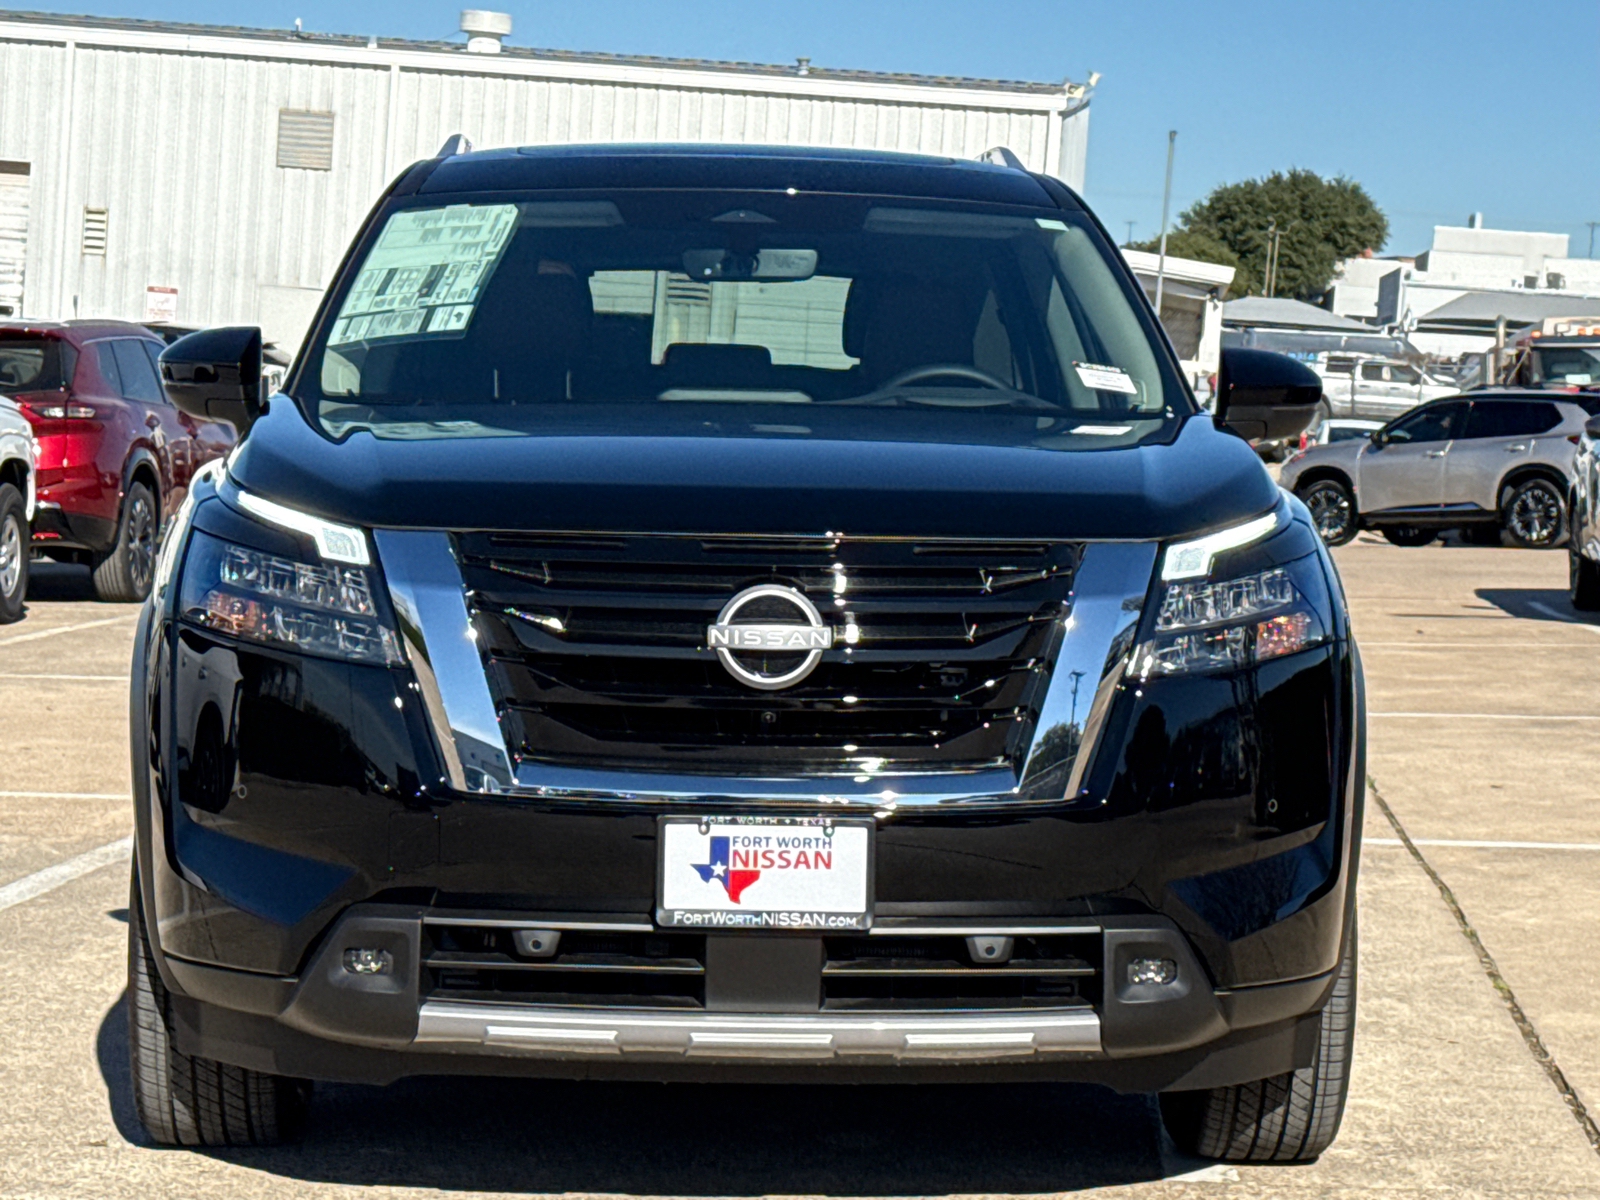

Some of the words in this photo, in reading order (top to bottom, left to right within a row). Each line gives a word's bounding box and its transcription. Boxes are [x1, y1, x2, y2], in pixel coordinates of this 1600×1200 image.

[710, 628, 829, 646] NISSAN
[702, 816, 730, 825] FORT
[737, 816, 778, 825] WORTH
[796, 818, 832, 827] TEXAS
[732, 836, 772, 848] FORT
[776, 837, 832, 849] WORTH
[732, 849, 832, 870] NISSAN
